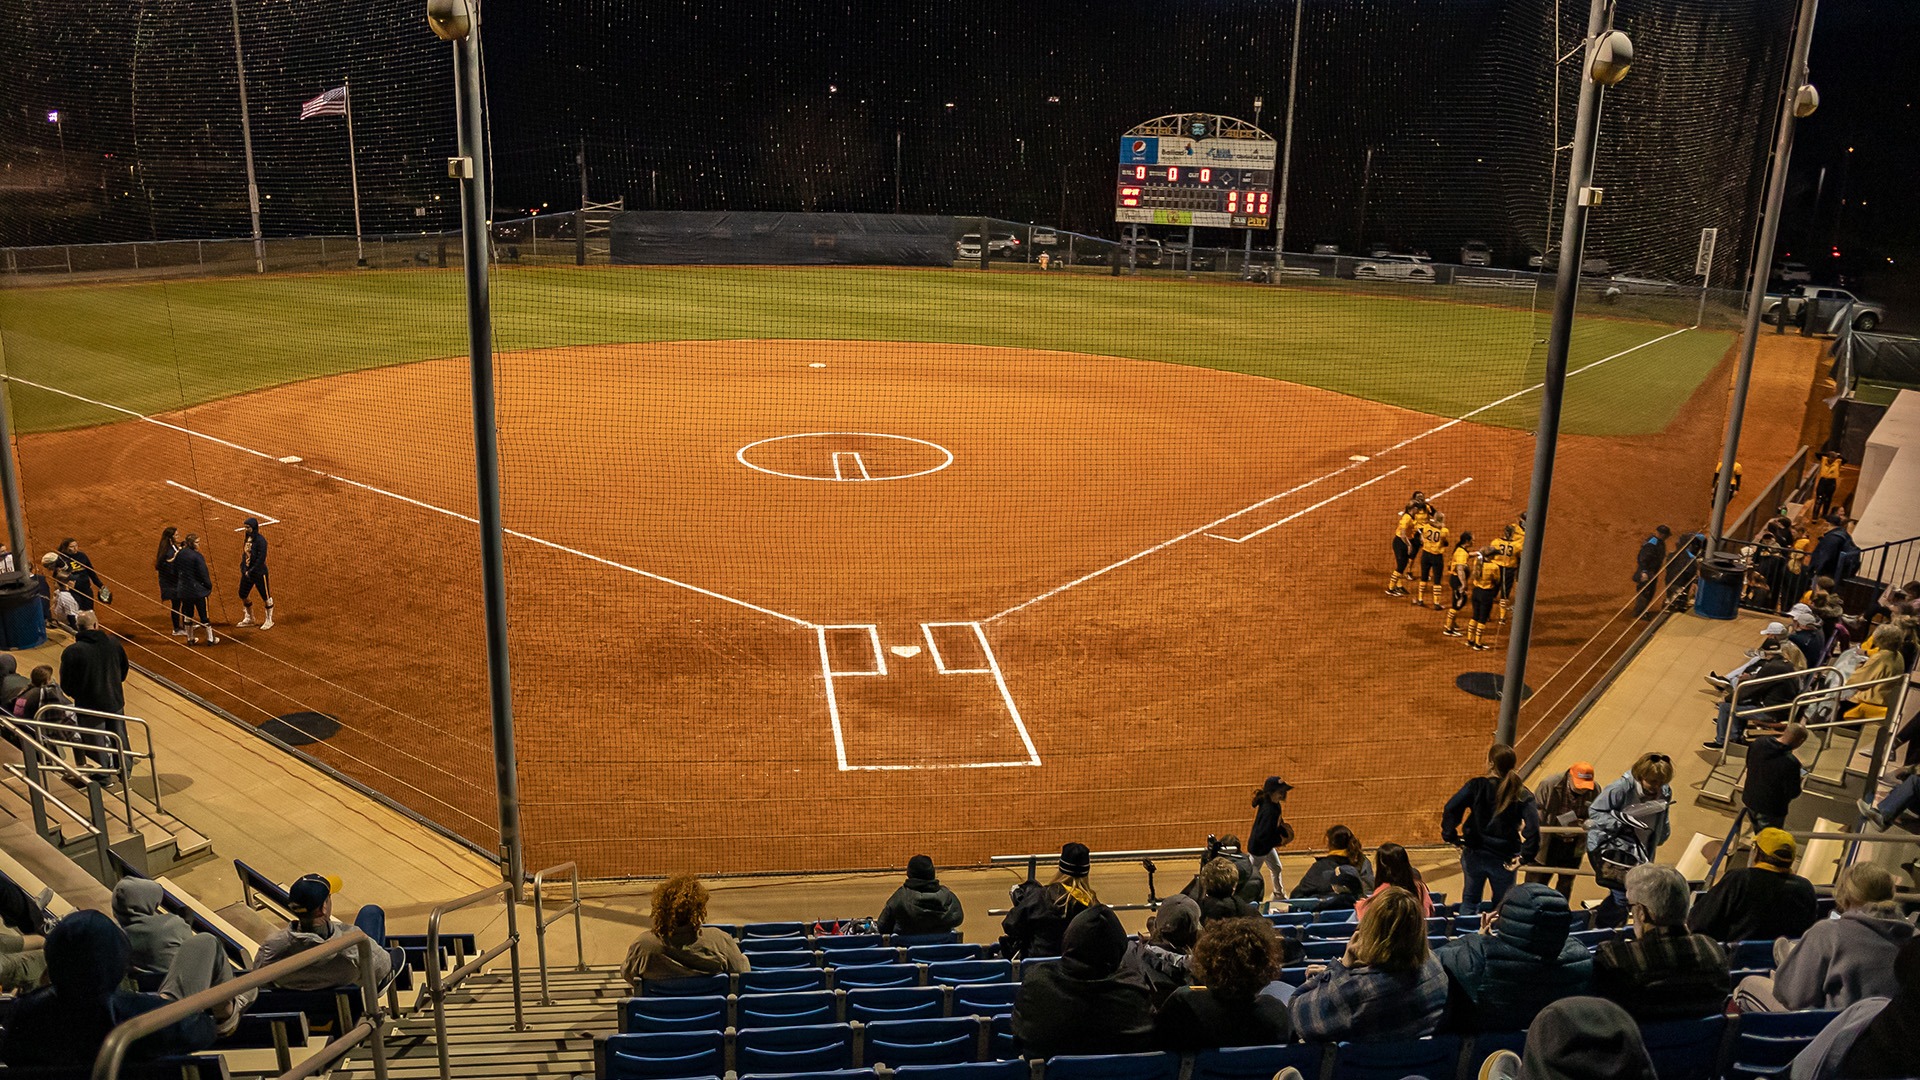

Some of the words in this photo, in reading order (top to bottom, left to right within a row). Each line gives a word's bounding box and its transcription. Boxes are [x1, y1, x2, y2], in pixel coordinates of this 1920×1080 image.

[1136, 166, 1146, 180] 0
[1168, 167, 1178, 182] 0
[1200, 168, 1210, 183] 0
[1426, 529, 1441, 543] 20
[1499, 543, 1514, 557] 33
